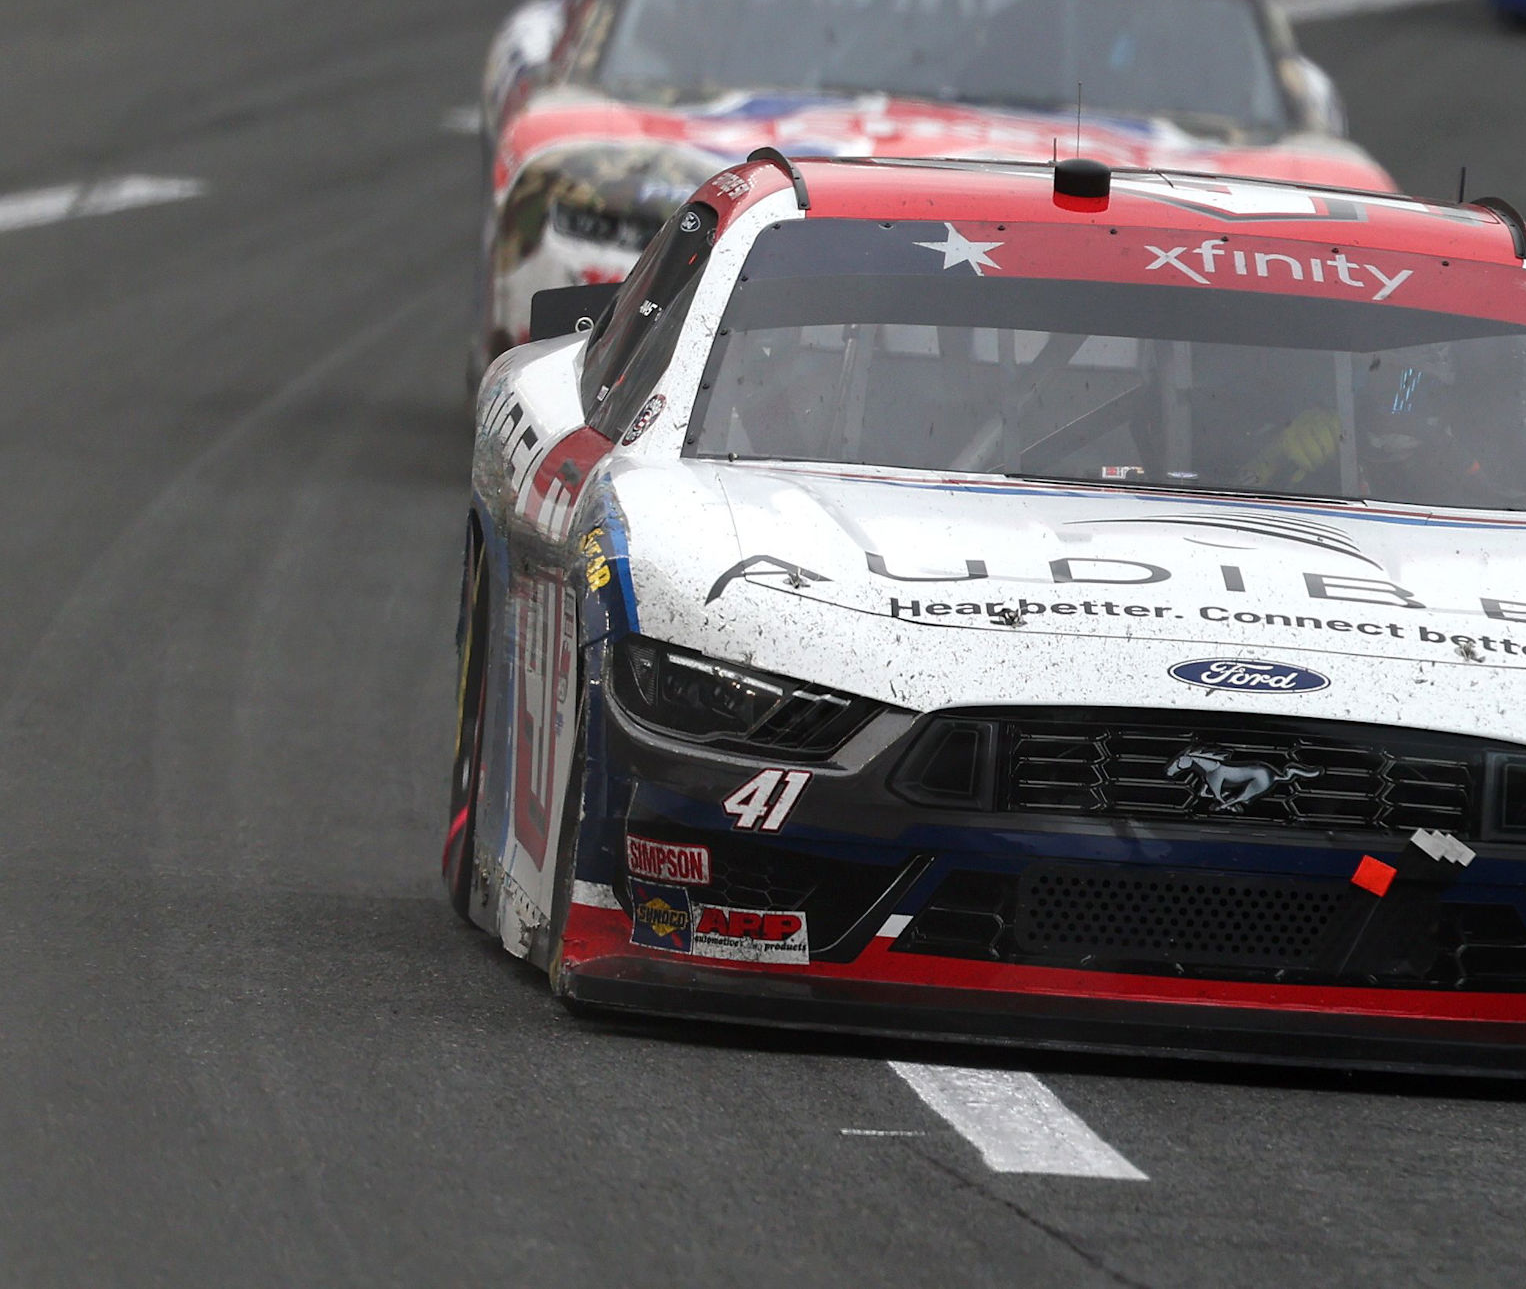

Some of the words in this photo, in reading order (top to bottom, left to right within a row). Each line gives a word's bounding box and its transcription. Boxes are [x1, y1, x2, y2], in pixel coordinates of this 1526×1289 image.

[1145, 241, 1413, 300] xfinity
[891, 596, 1015, 621] Hear
[1019, 598, 1184, 620] better.
[1200, 606, 1416, 642] Connect
[1198, 660, 1298, 693] Ford
[723, 769, 812, 832] 41
[629, 840, 703, 880] SIMPSON
[638, 907, 686, 927] SUNOCO
[696, 907, 803, 942] ARP
[764, 942, 807, 953] products
